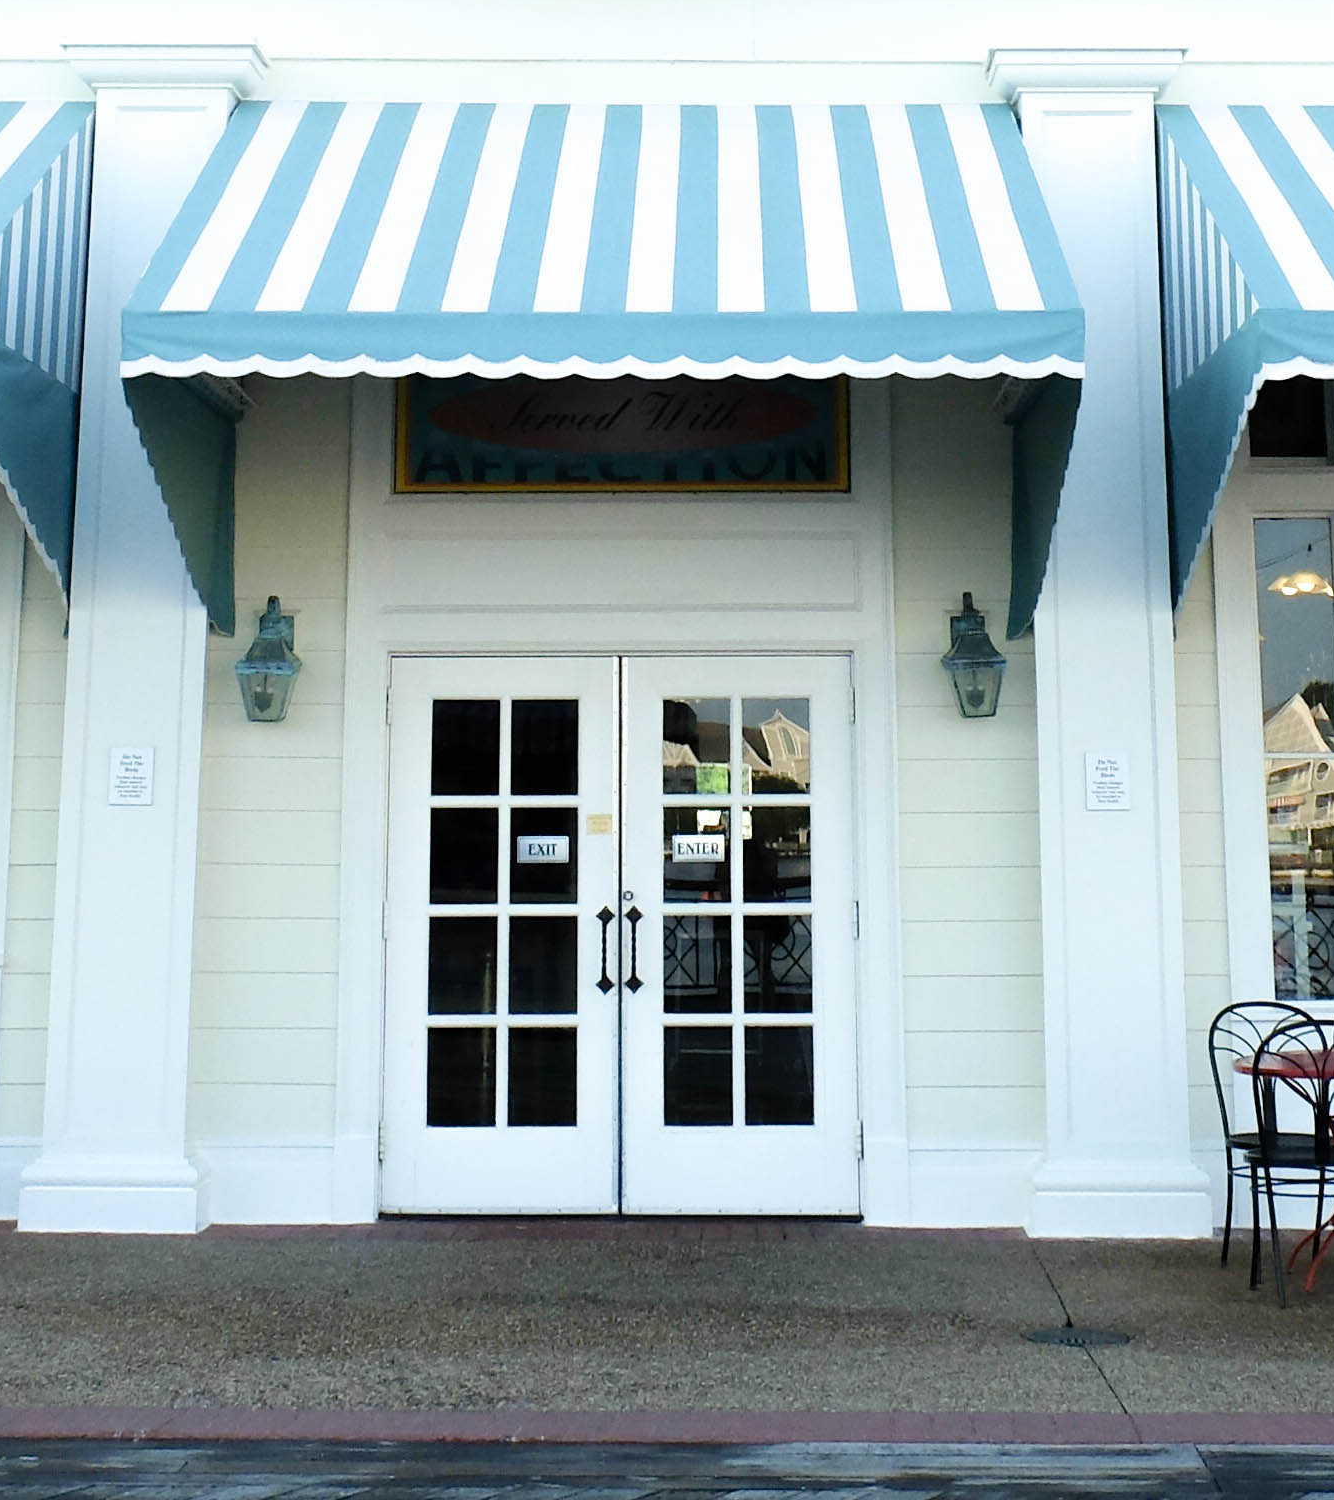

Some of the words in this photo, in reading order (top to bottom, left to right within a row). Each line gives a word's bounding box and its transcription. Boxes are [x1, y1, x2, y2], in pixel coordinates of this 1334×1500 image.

[489, 391, 634, 434] Served
[639, 390, 741, 434] With
[528, 843, 557, 856] EXIT
[677, 842, 719, 855] ENTER
